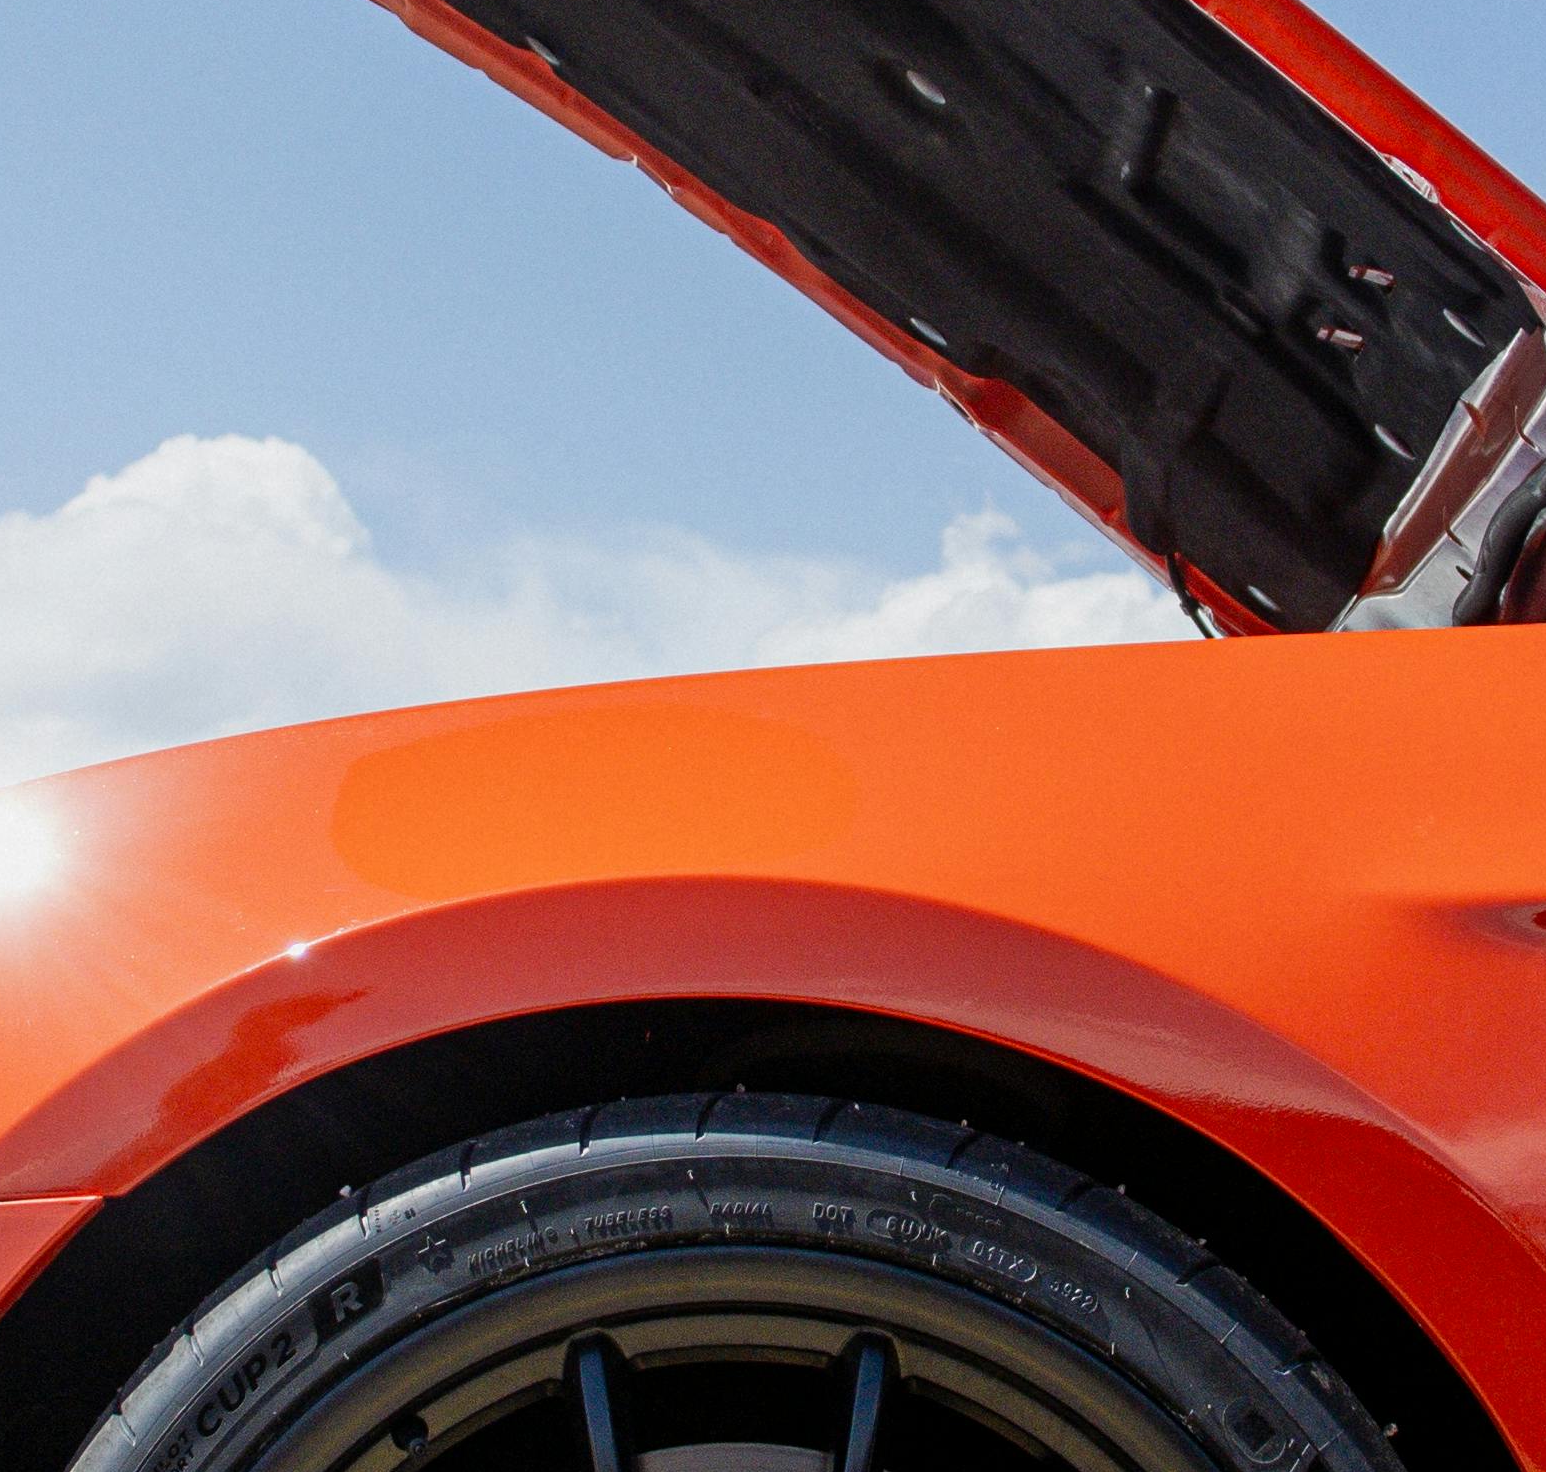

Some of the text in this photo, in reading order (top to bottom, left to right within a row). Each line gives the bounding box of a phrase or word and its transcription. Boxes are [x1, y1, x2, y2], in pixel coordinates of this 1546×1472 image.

[582, 1203, 673, 1232] TUBELESS
[812, 1201, 852, 1225] DOT
[320, 1275, 370, 1324] R
